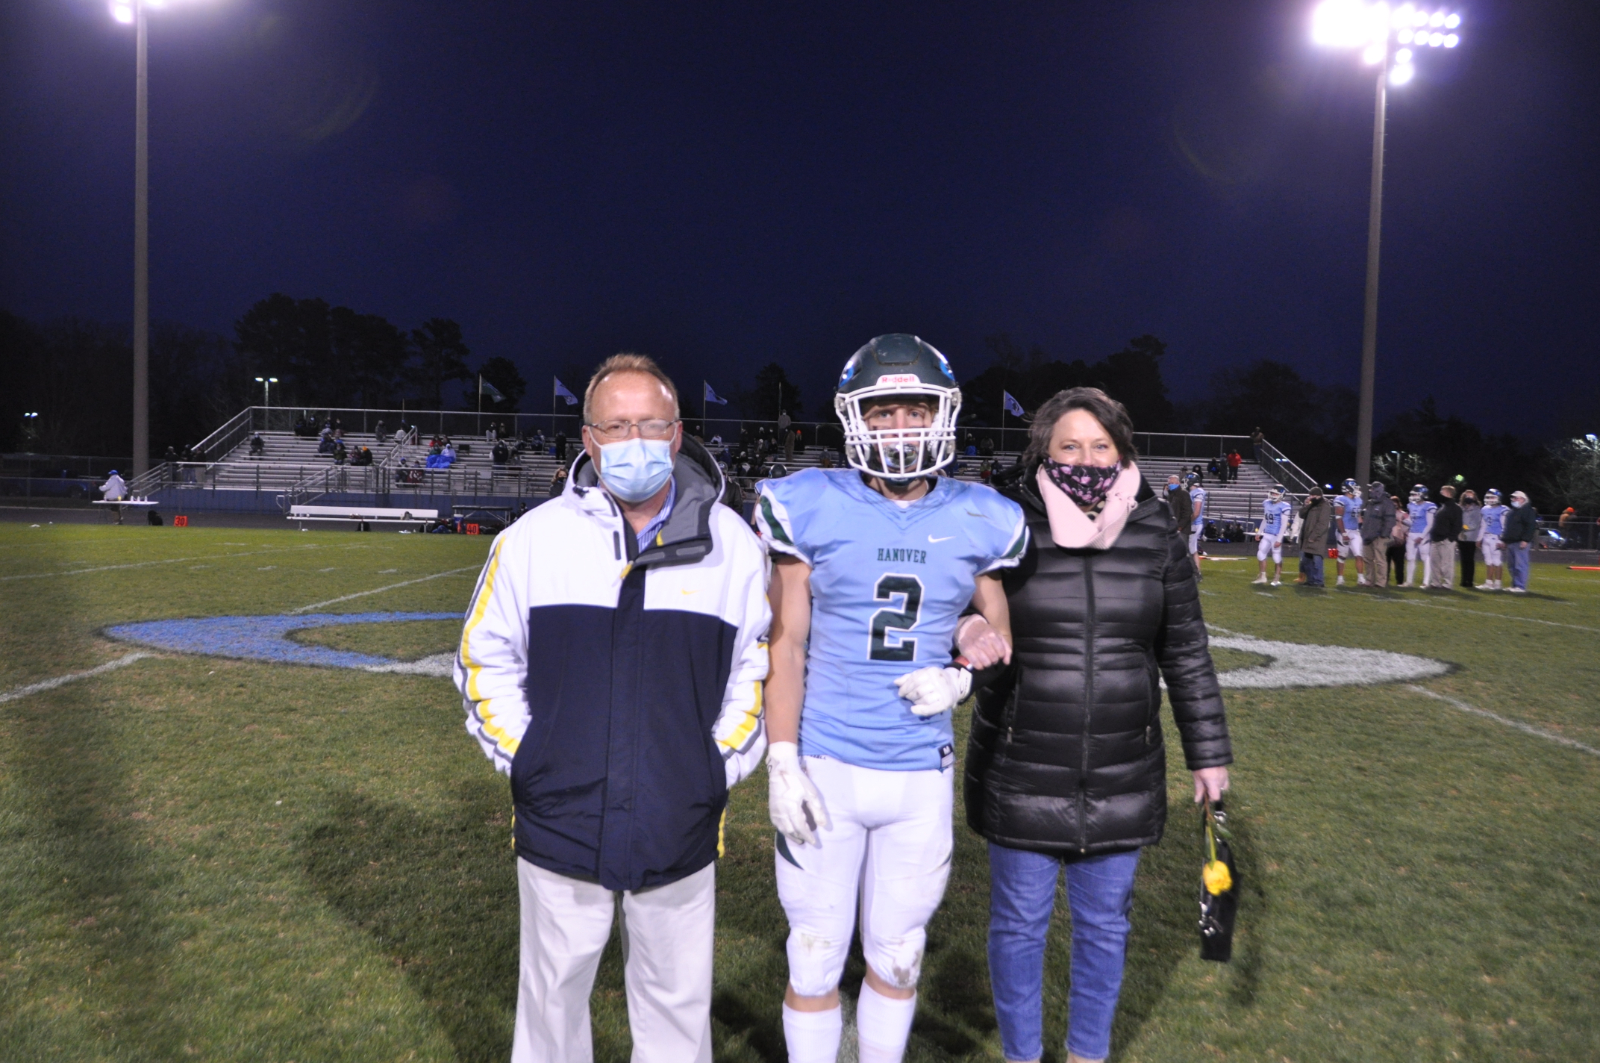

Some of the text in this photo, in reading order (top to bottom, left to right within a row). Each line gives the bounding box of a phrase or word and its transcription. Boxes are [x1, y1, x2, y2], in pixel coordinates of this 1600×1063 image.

[467, 524, 477, 534] 40
[877, 548, 927, 564] HANOVER
[867, 572, 925, 662] 2
